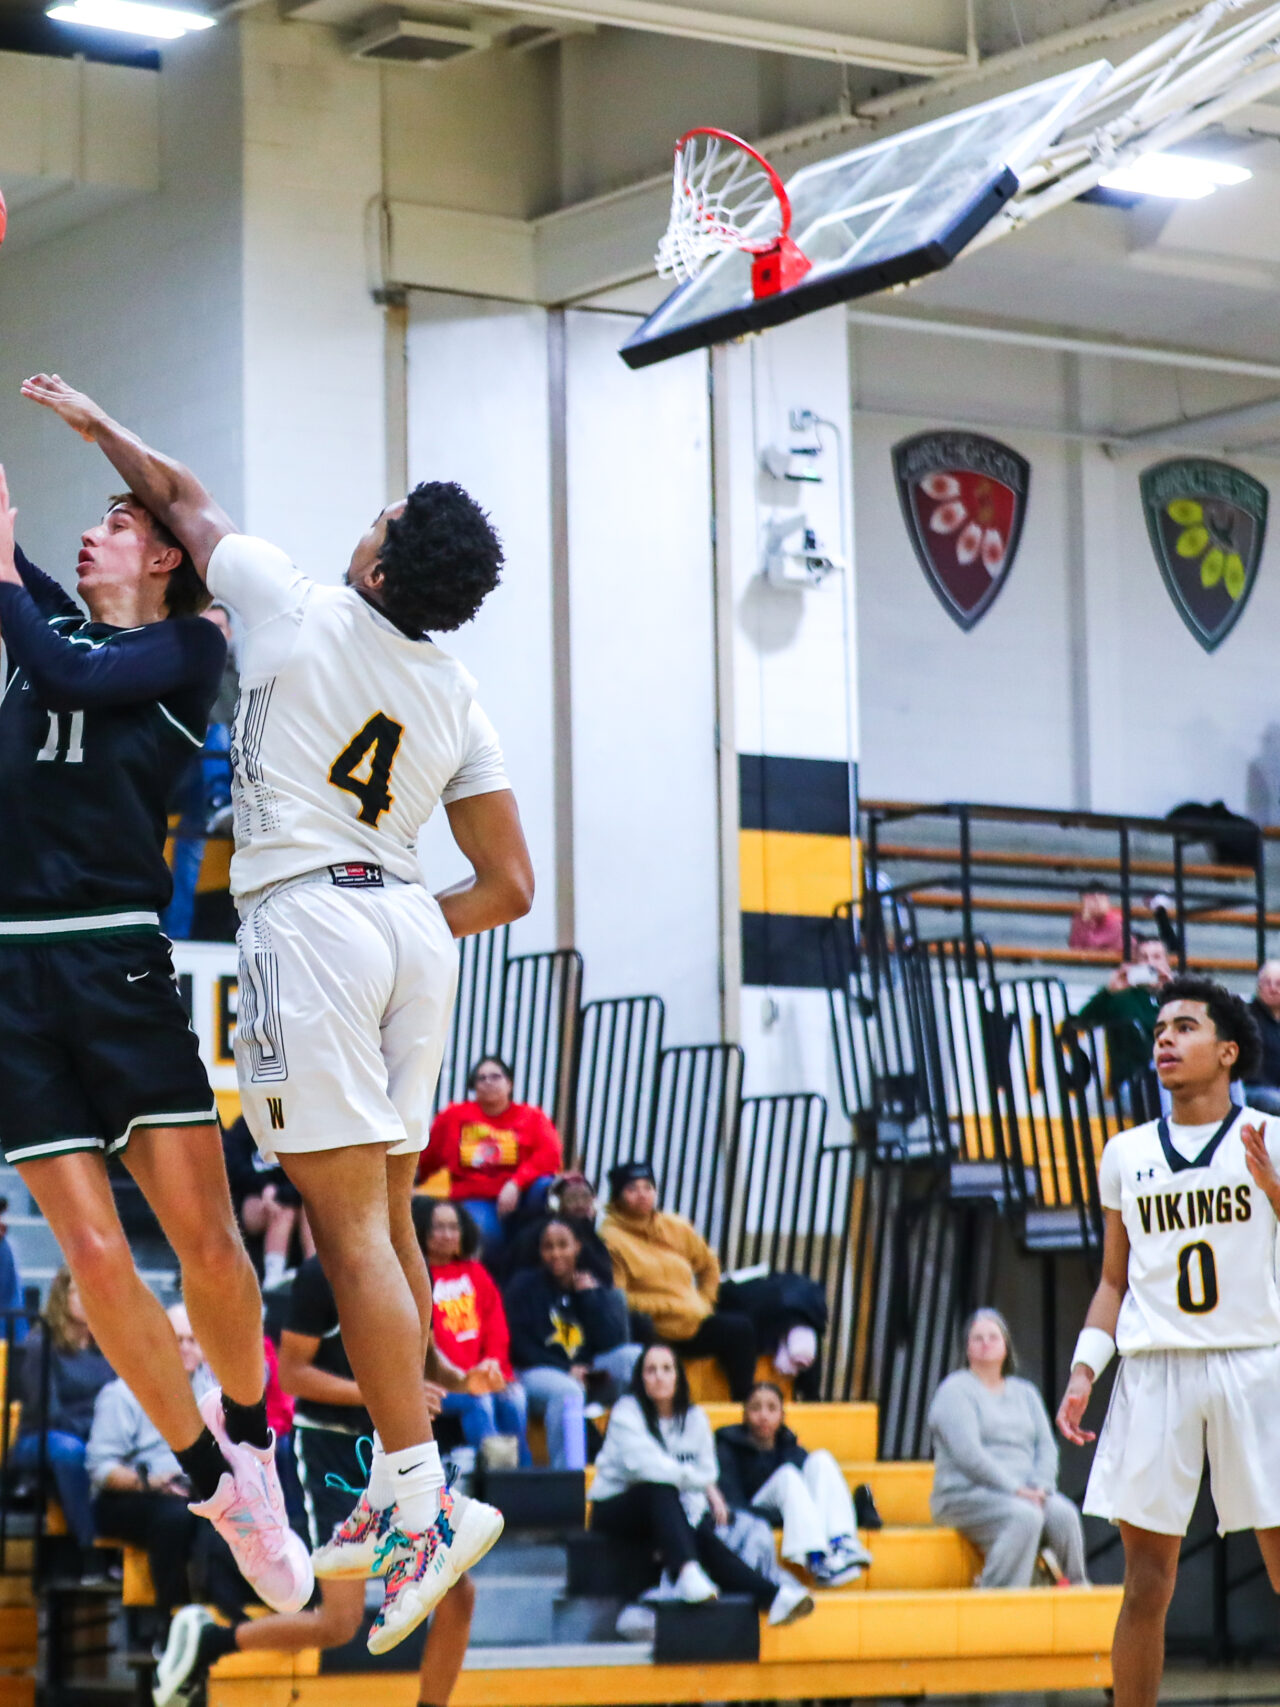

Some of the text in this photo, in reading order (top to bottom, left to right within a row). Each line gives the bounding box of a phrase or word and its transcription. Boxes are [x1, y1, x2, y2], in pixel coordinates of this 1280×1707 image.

[36, 708, 84, 763] 11
[326, 709, 406, 831] 4
[265, 1096, 285, 1130] W
[1136, 1184, 1253, 1235] VIKINGS
[1176, 1239, 1220, 1316] 0
